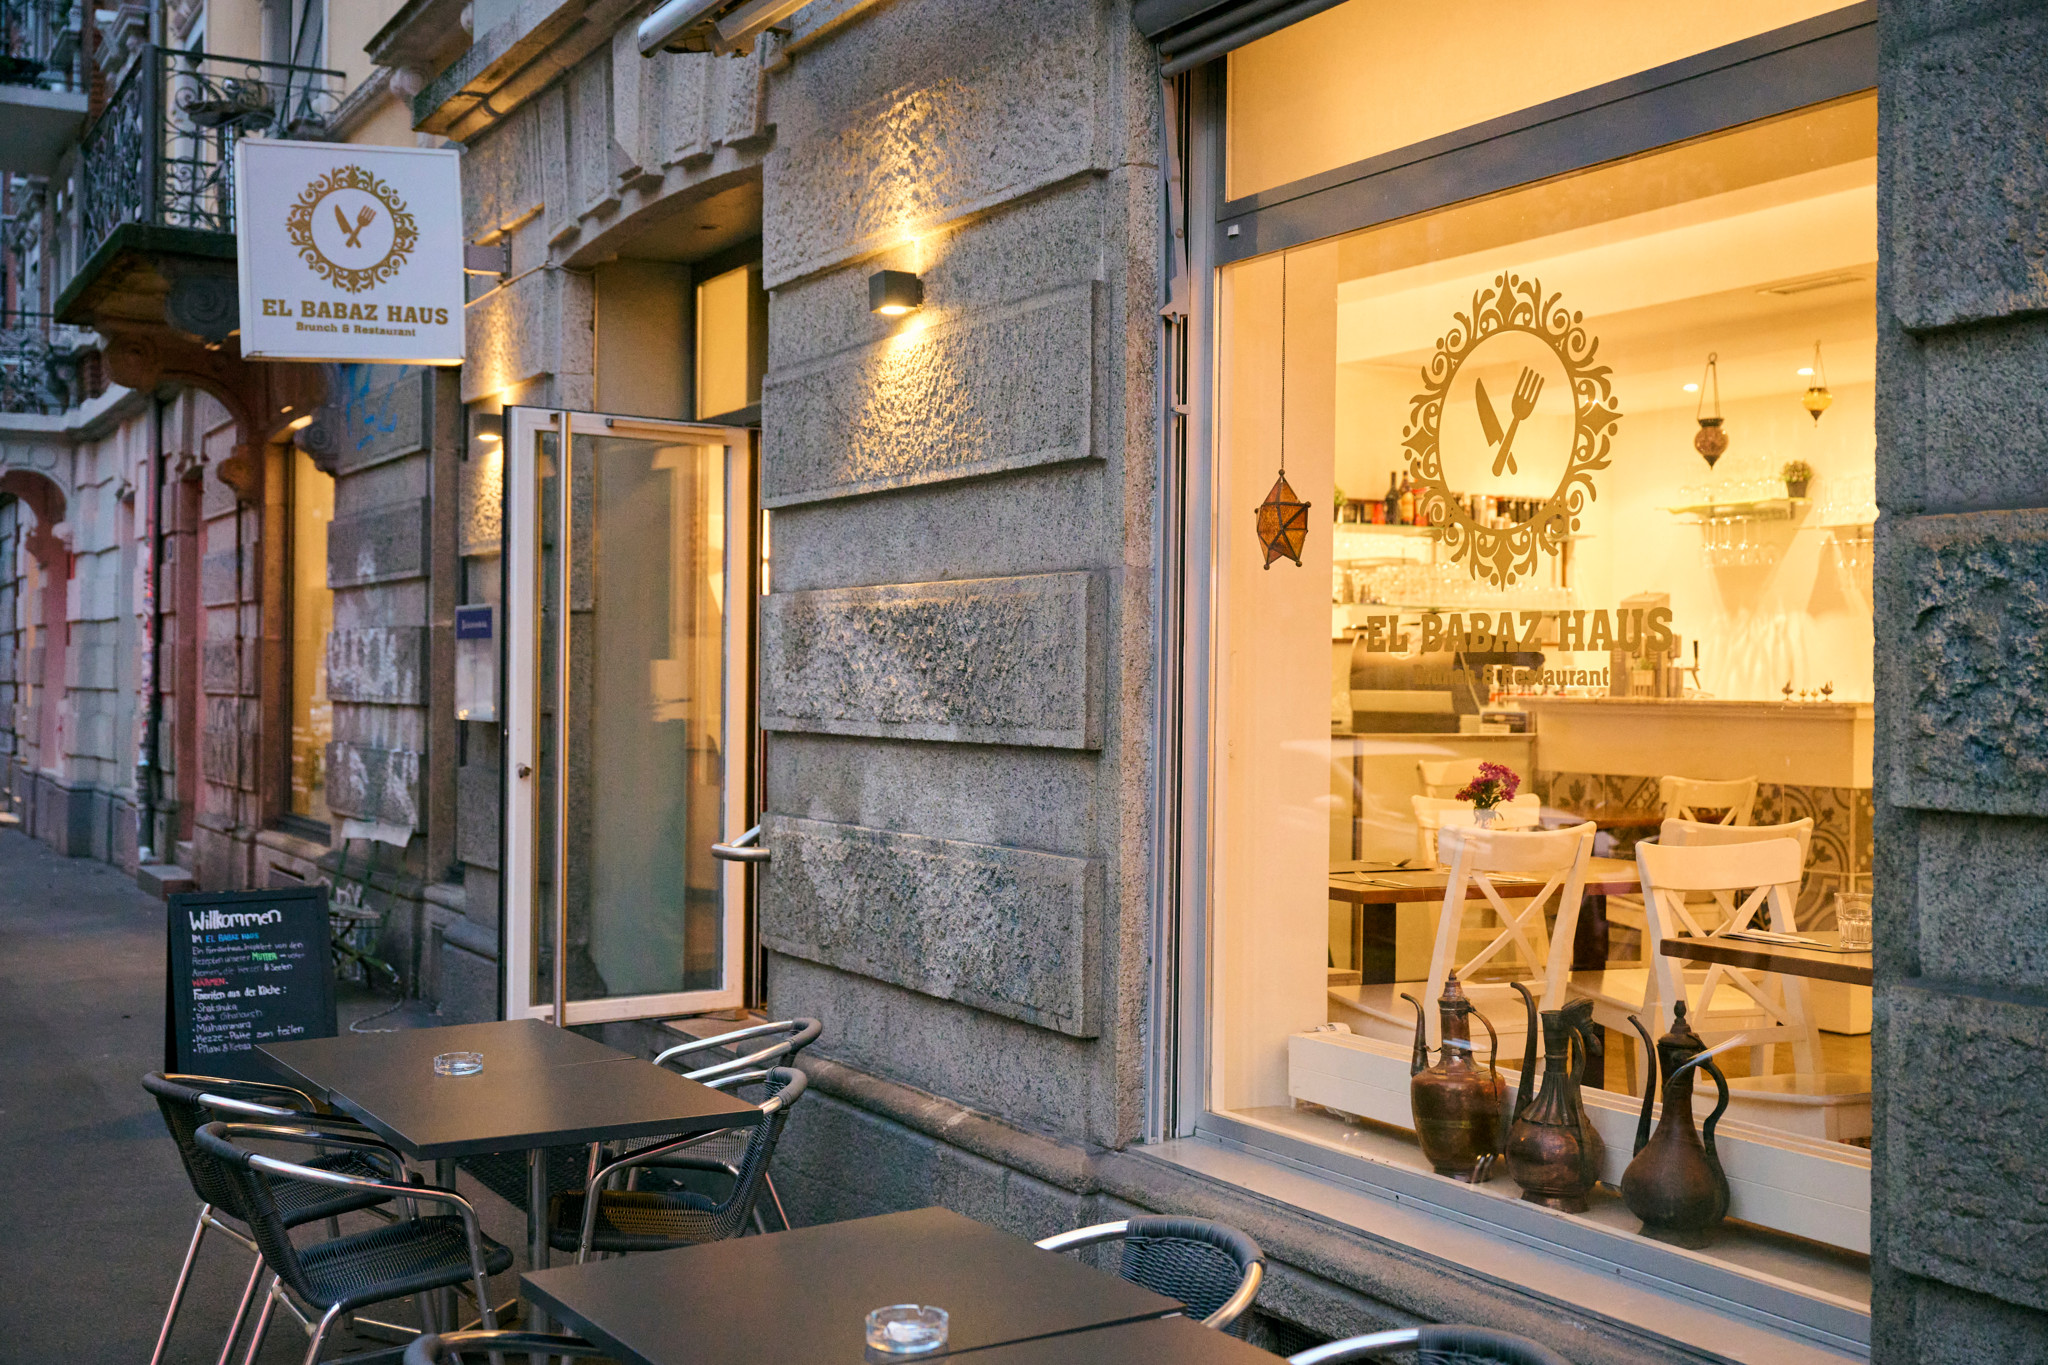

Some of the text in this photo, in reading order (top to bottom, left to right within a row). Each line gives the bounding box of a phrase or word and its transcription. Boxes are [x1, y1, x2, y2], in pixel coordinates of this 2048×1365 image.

[262, 299, 449, 325] EL BABAZ HAUS
[296, 322, 416, 337] Brunch & Restaurant
[1366, 607, 1673, 653] EL BABAZ HAUS
[1482, 664, 1493, 685] &
[1501, 664, 1609, 687] Restaurant
[189, 909, 282, 931] Willkommen
[191, 934, 203, 944] IM
[205, 934, 217, 943] EL
[241, 932, 260, 941] HAUS
